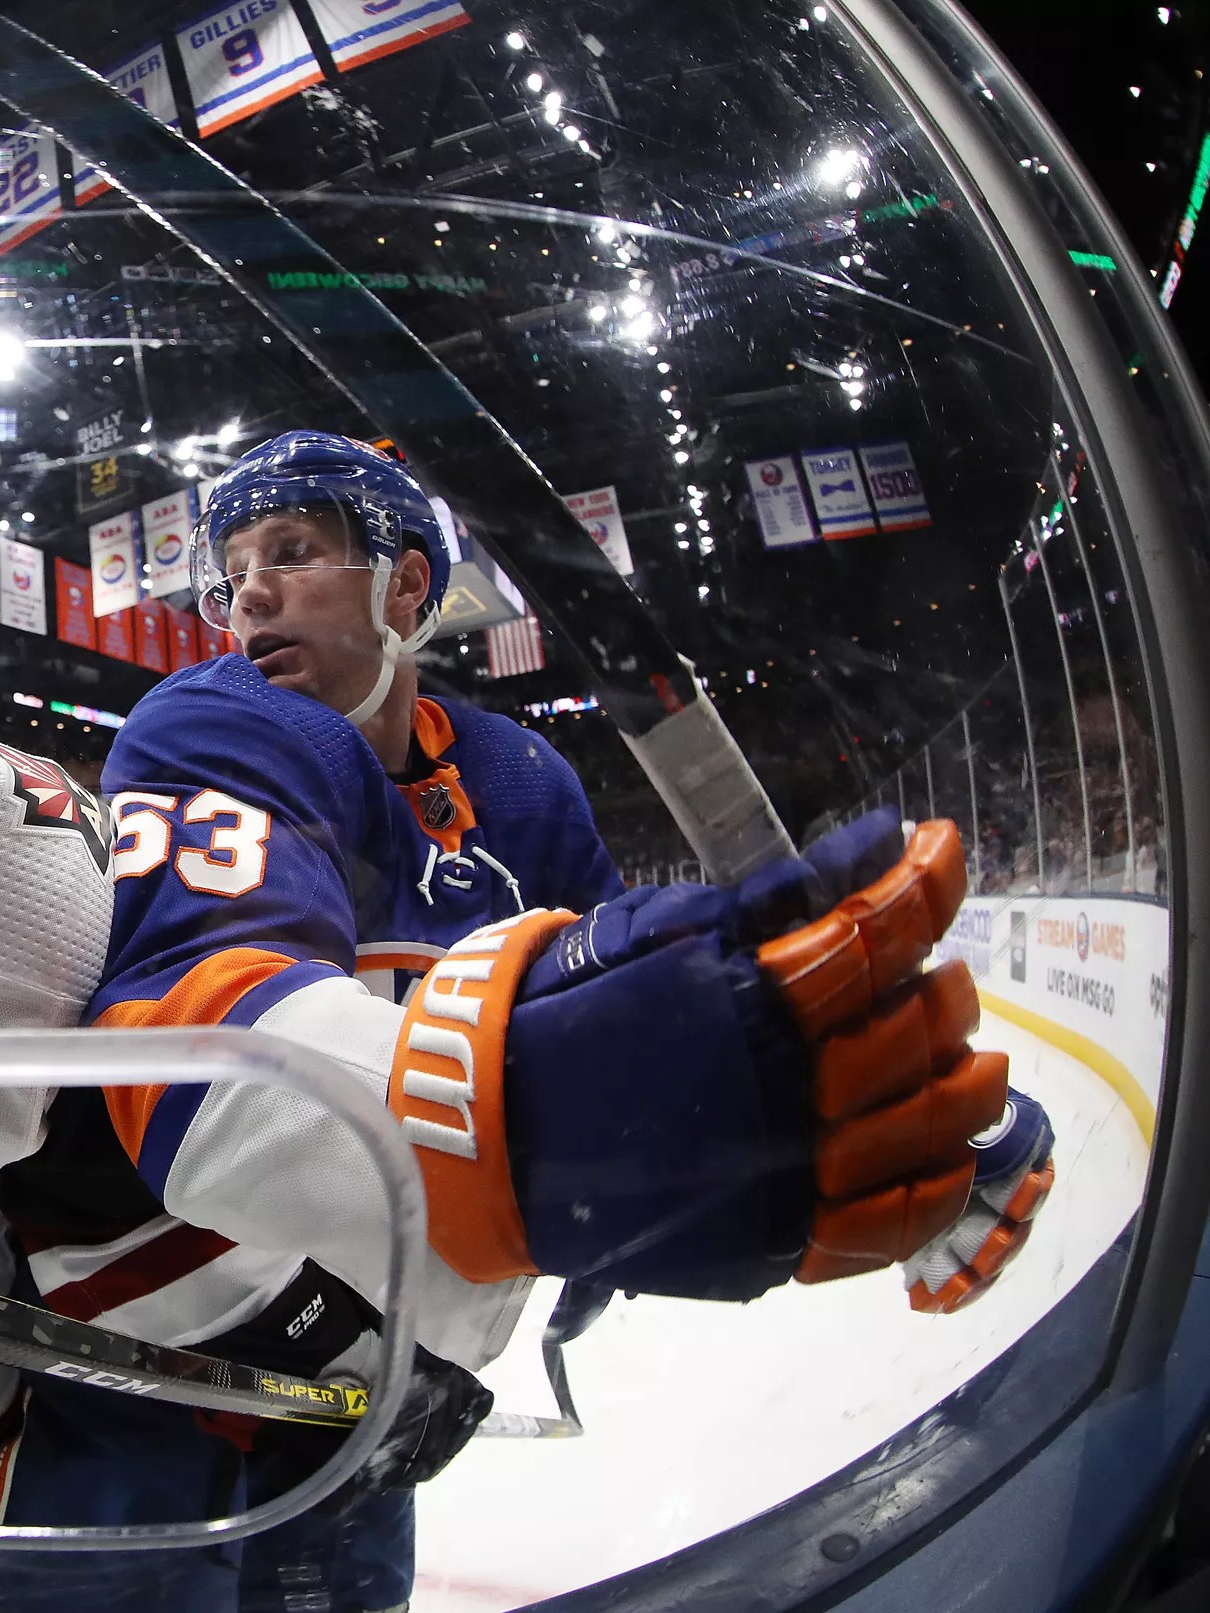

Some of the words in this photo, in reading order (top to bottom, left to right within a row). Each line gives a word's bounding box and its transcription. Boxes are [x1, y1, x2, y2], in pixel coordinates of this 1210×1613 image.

[189, 0, 278, 49] GILLIES
[221, 28, 264, 77] 9
[114, 789, 272, 898] 53
[1037, 919, 1075, 950] STREAM
[1092, 922, 1126, 962] GAMES
[1047, 967, 1065, 995] LIVE
[1066, 972, 1080, 1002] ON
[286, 1293, 323, 1337] CCM
[44, 1360, 161, 1395] CCM
[261, 1377, 336, 1405] SUPER
